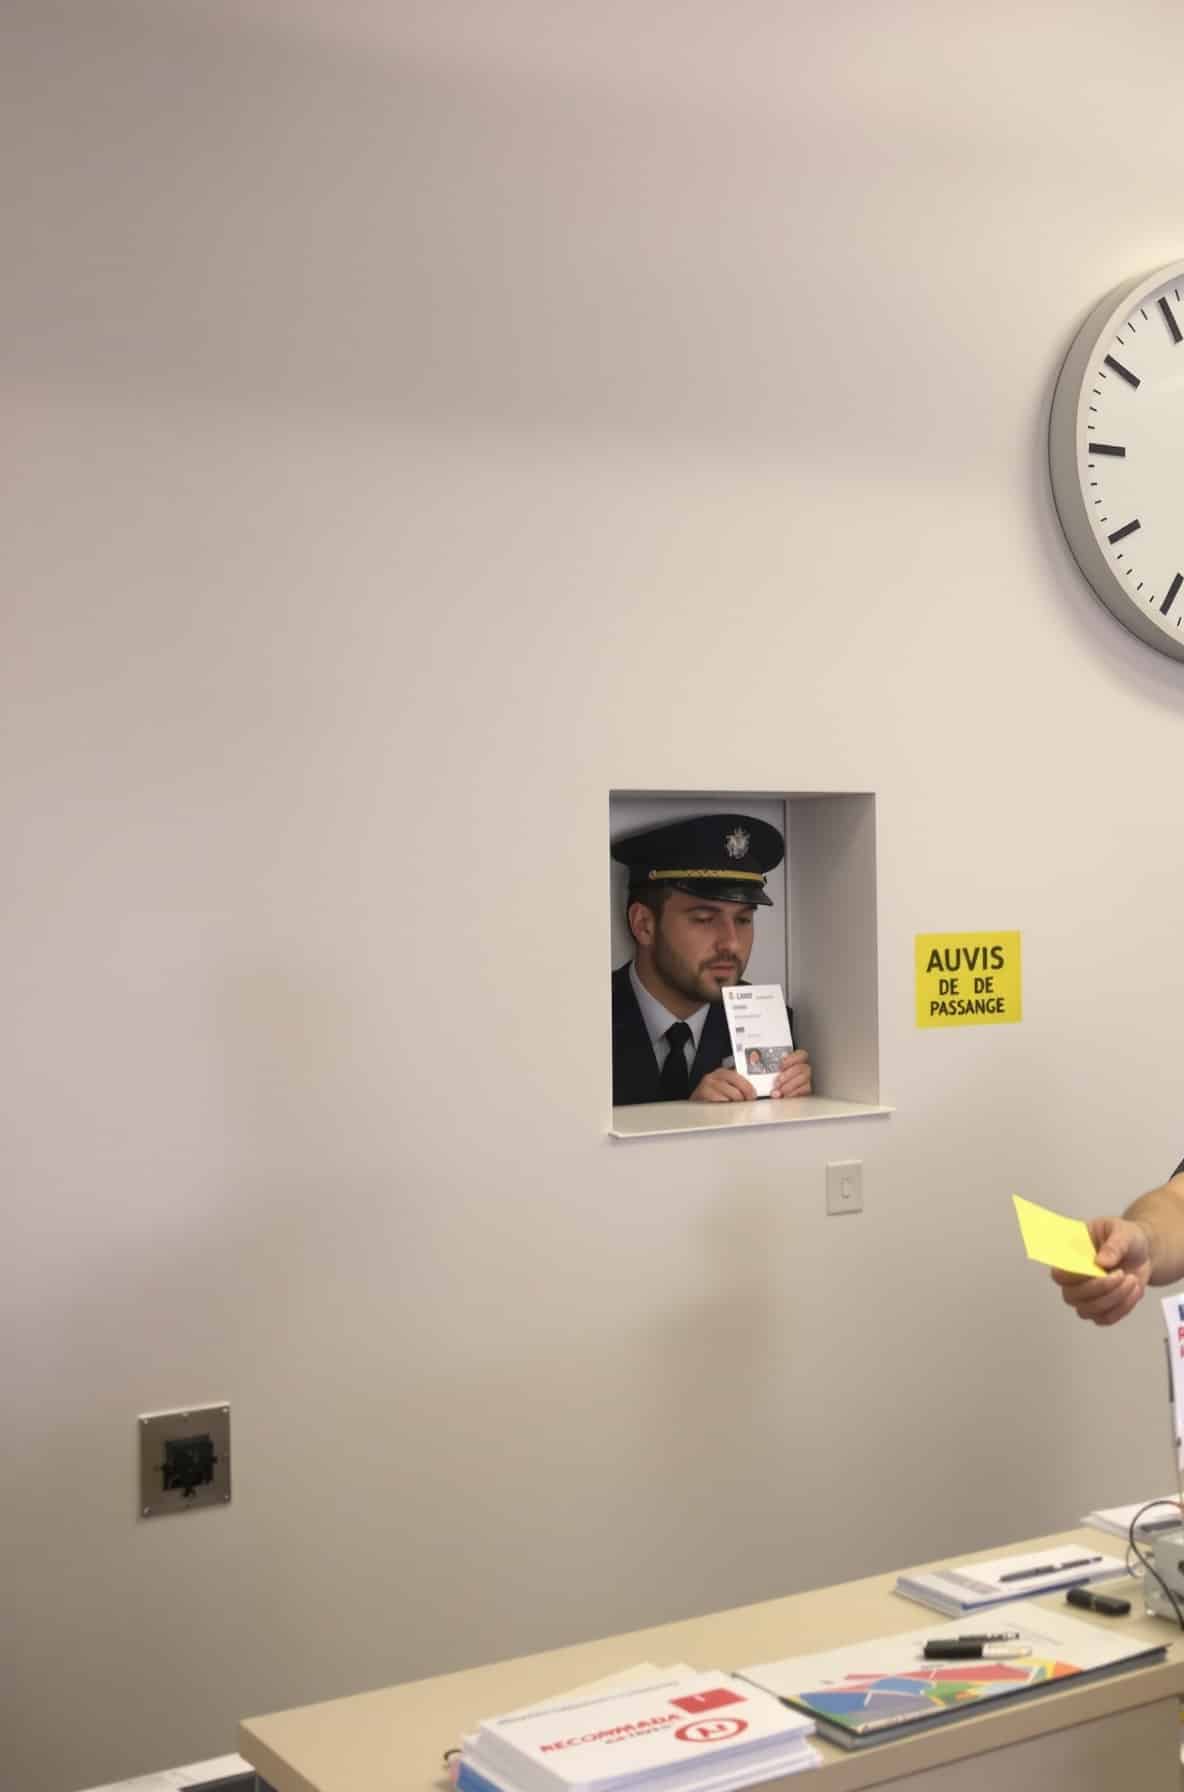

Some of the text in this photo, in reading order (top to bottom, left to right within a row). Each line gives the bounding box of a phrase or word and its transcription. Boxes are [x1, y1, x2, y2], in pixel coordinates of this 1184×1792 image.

[926, 945, 1005, 973] AUVIS
[938, 976, 995, 996] DE DE
[930, 997, 1006, 1016] PASSANGE
